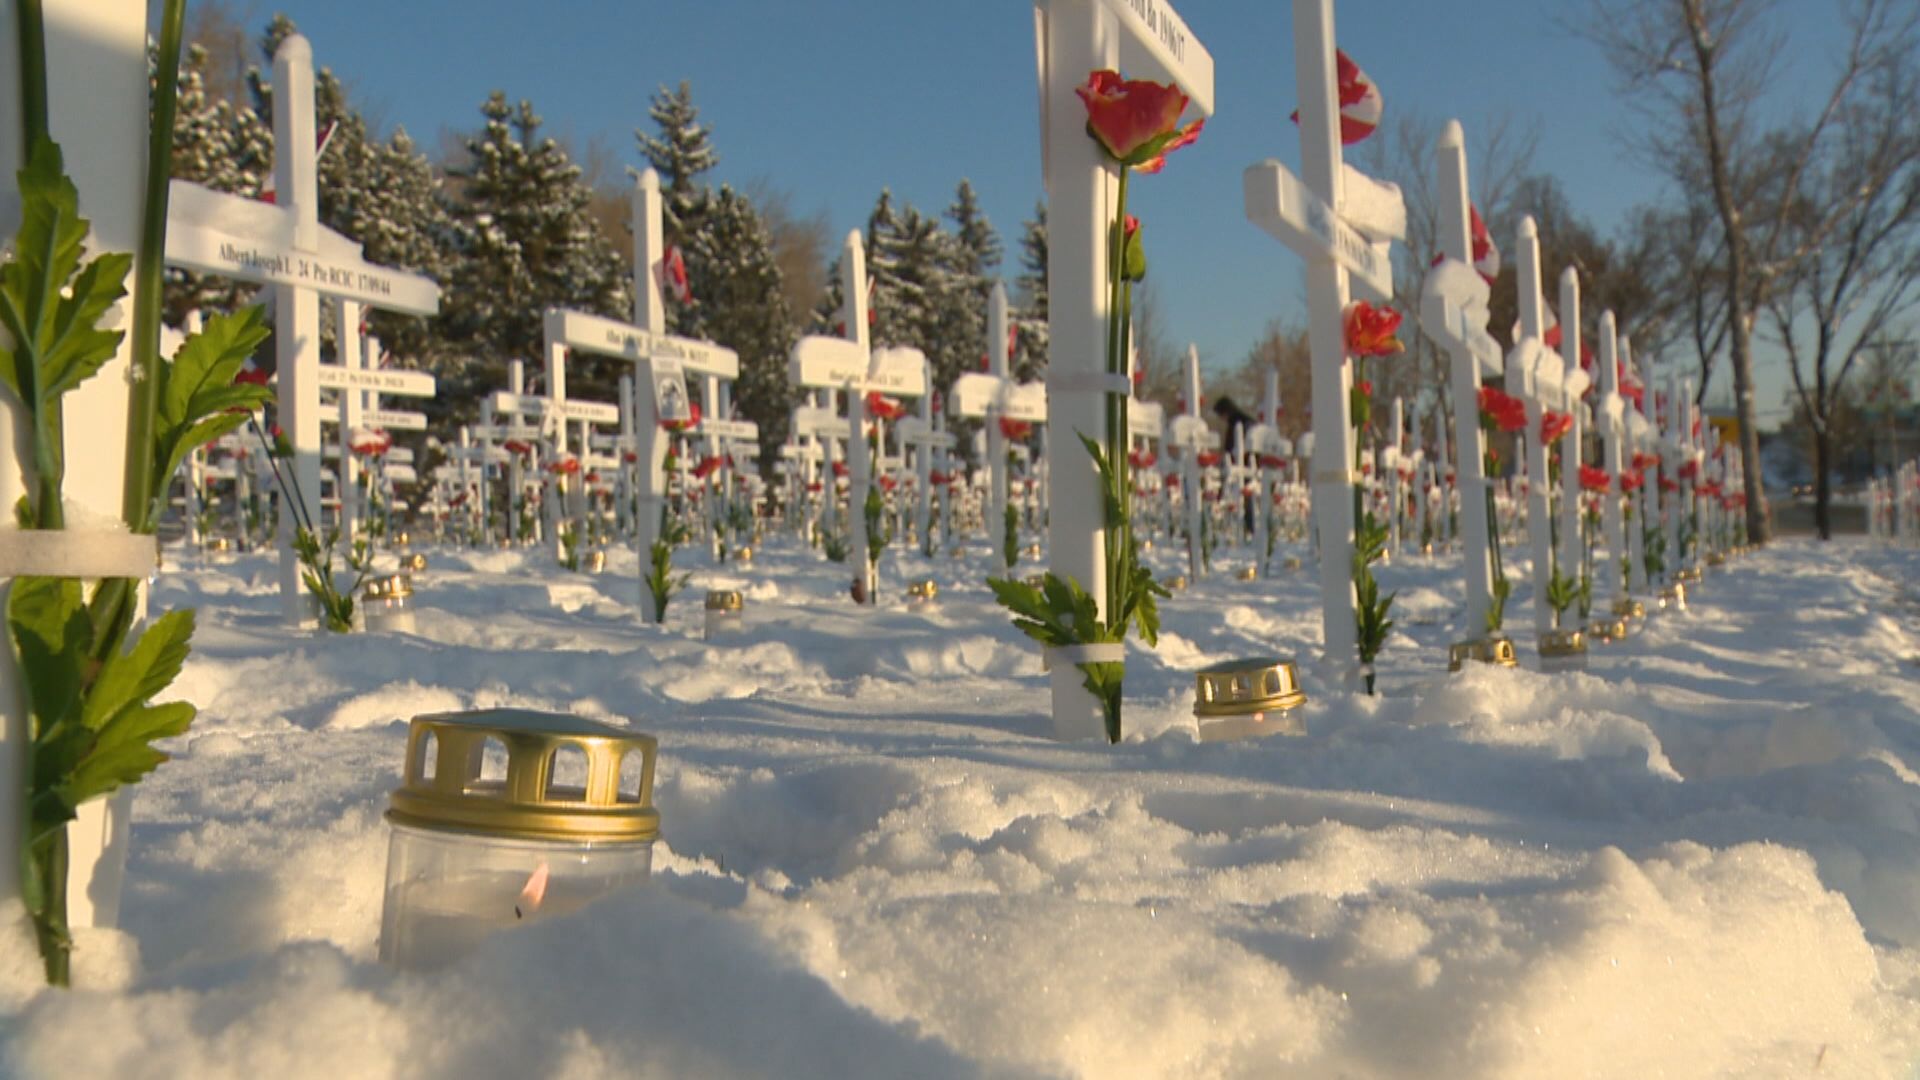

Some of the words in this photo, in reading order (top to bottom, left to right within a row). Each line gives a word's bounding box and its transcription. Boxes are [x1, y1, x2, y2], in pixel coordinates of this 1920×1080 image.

[220, 242, 250, 267] Albert
[251, 248, 284, 277] Joseph
[298, 258, 309, 278] 24
